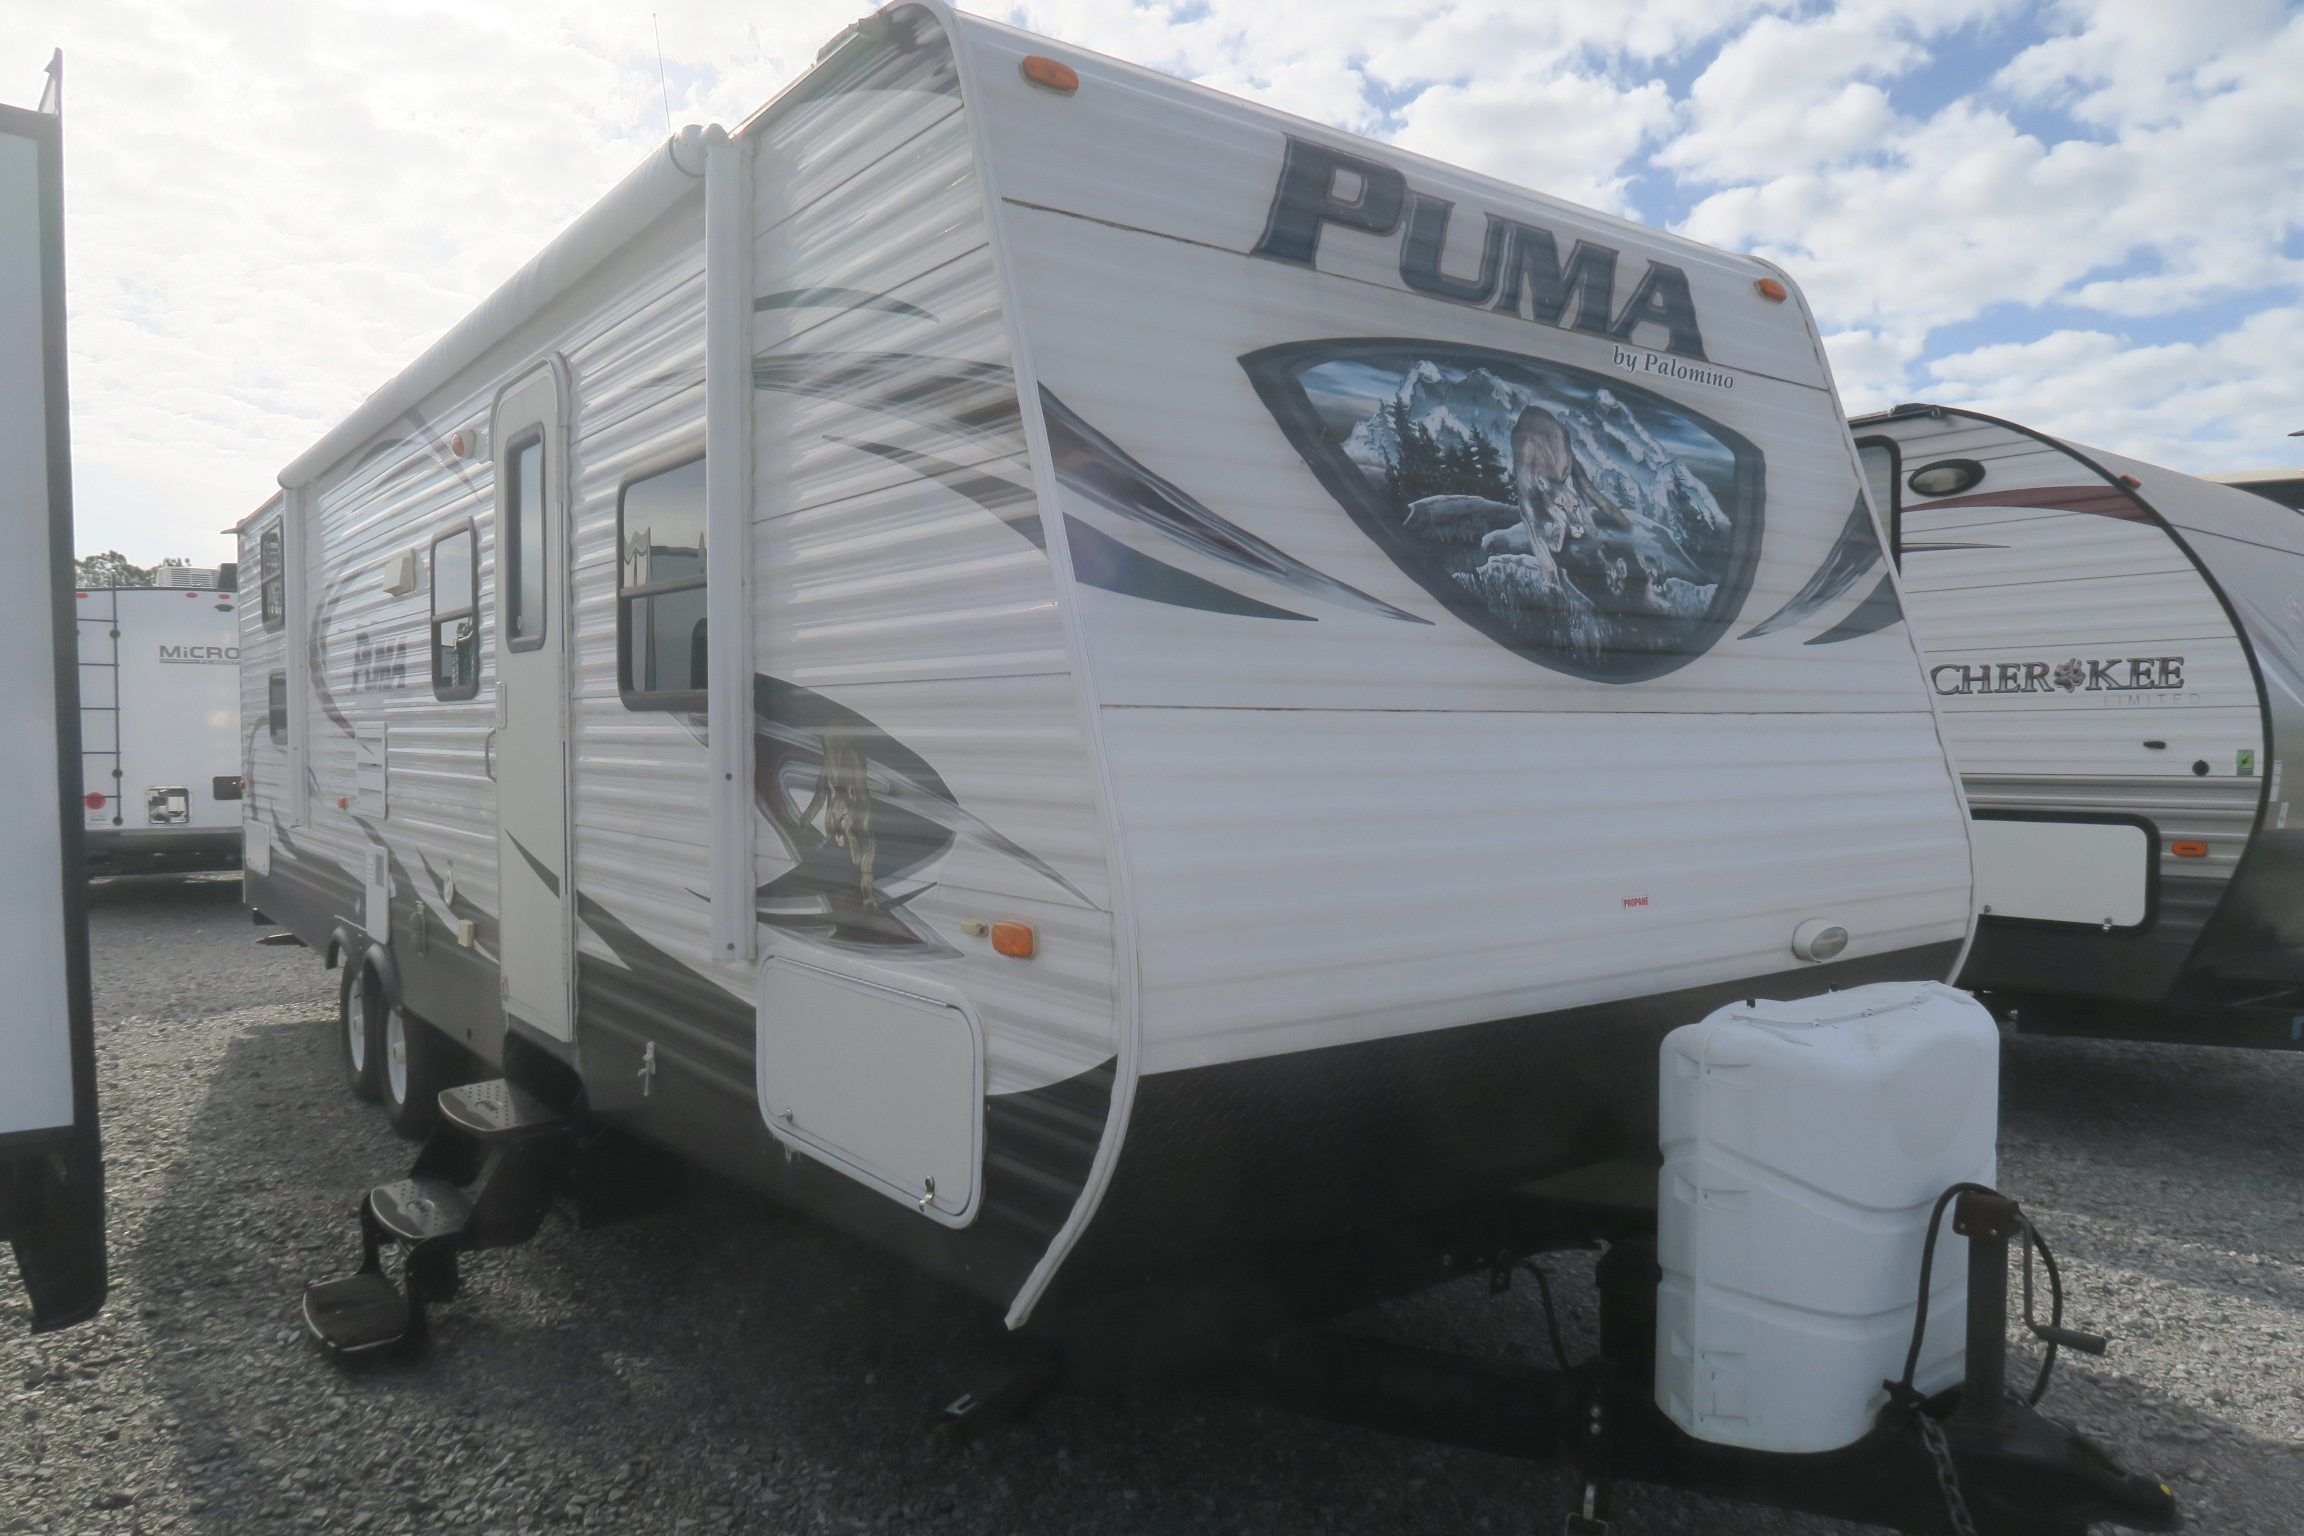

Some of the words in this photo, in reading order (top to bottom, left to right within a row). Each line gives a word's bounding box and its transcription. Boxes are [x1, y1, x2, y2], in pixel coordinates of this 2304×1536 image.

[1249, 131, 1709, 363] PUMA
[1613, 345, 1638, 374] by
[1644, 352, 1734, 390] Palomino
[2103, 693, 2201, 707] LIMITED
[1623, 896, 1649, 908] PROPANE
